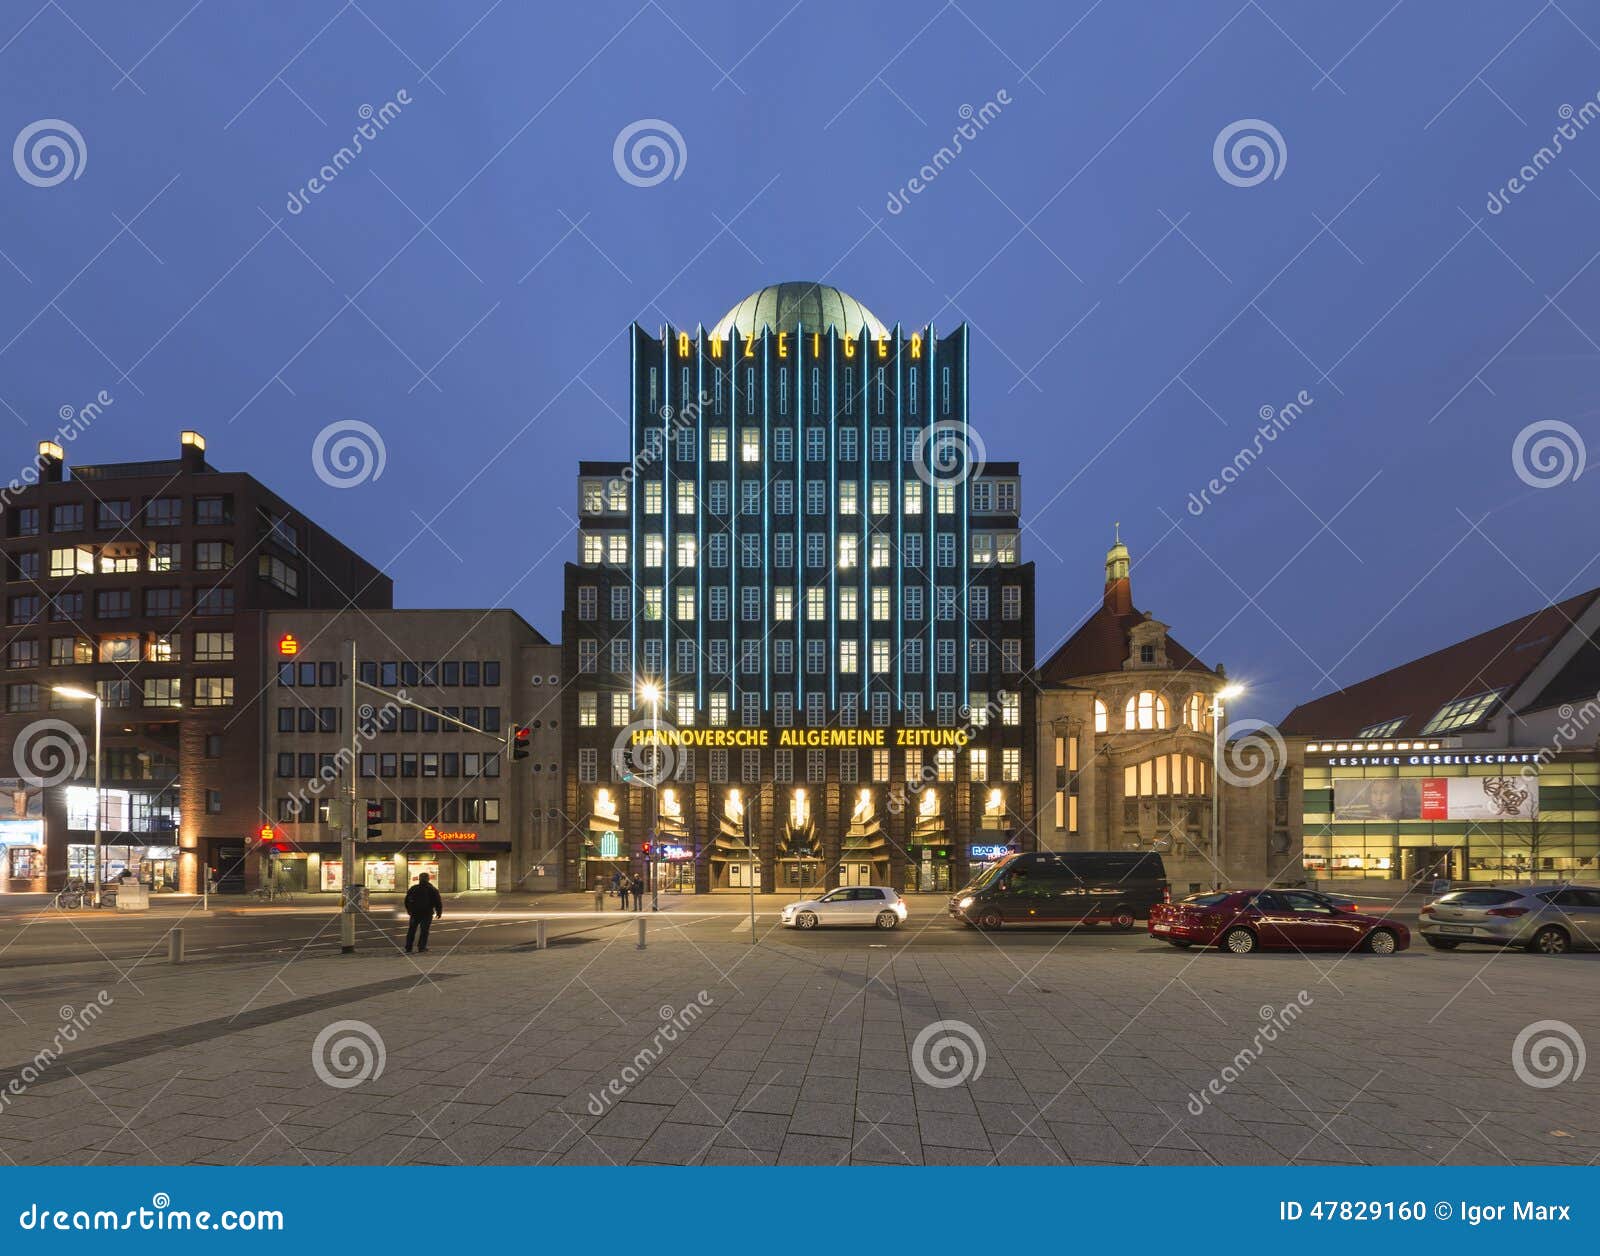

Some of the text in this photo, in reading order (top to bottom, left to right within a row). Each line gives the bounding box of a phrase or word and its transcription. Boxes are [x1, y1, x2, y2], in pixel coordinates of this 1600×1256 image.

[678, 331, 922, 358] ANZEIGER
[631, 729, 969, 746] HANNOVERSCHE ALLGEMEINE ZEITUNG
[1409, 755, 1539, 765] GESELLSCHAFT
[438, 831, 476, 840] Sparkasse
